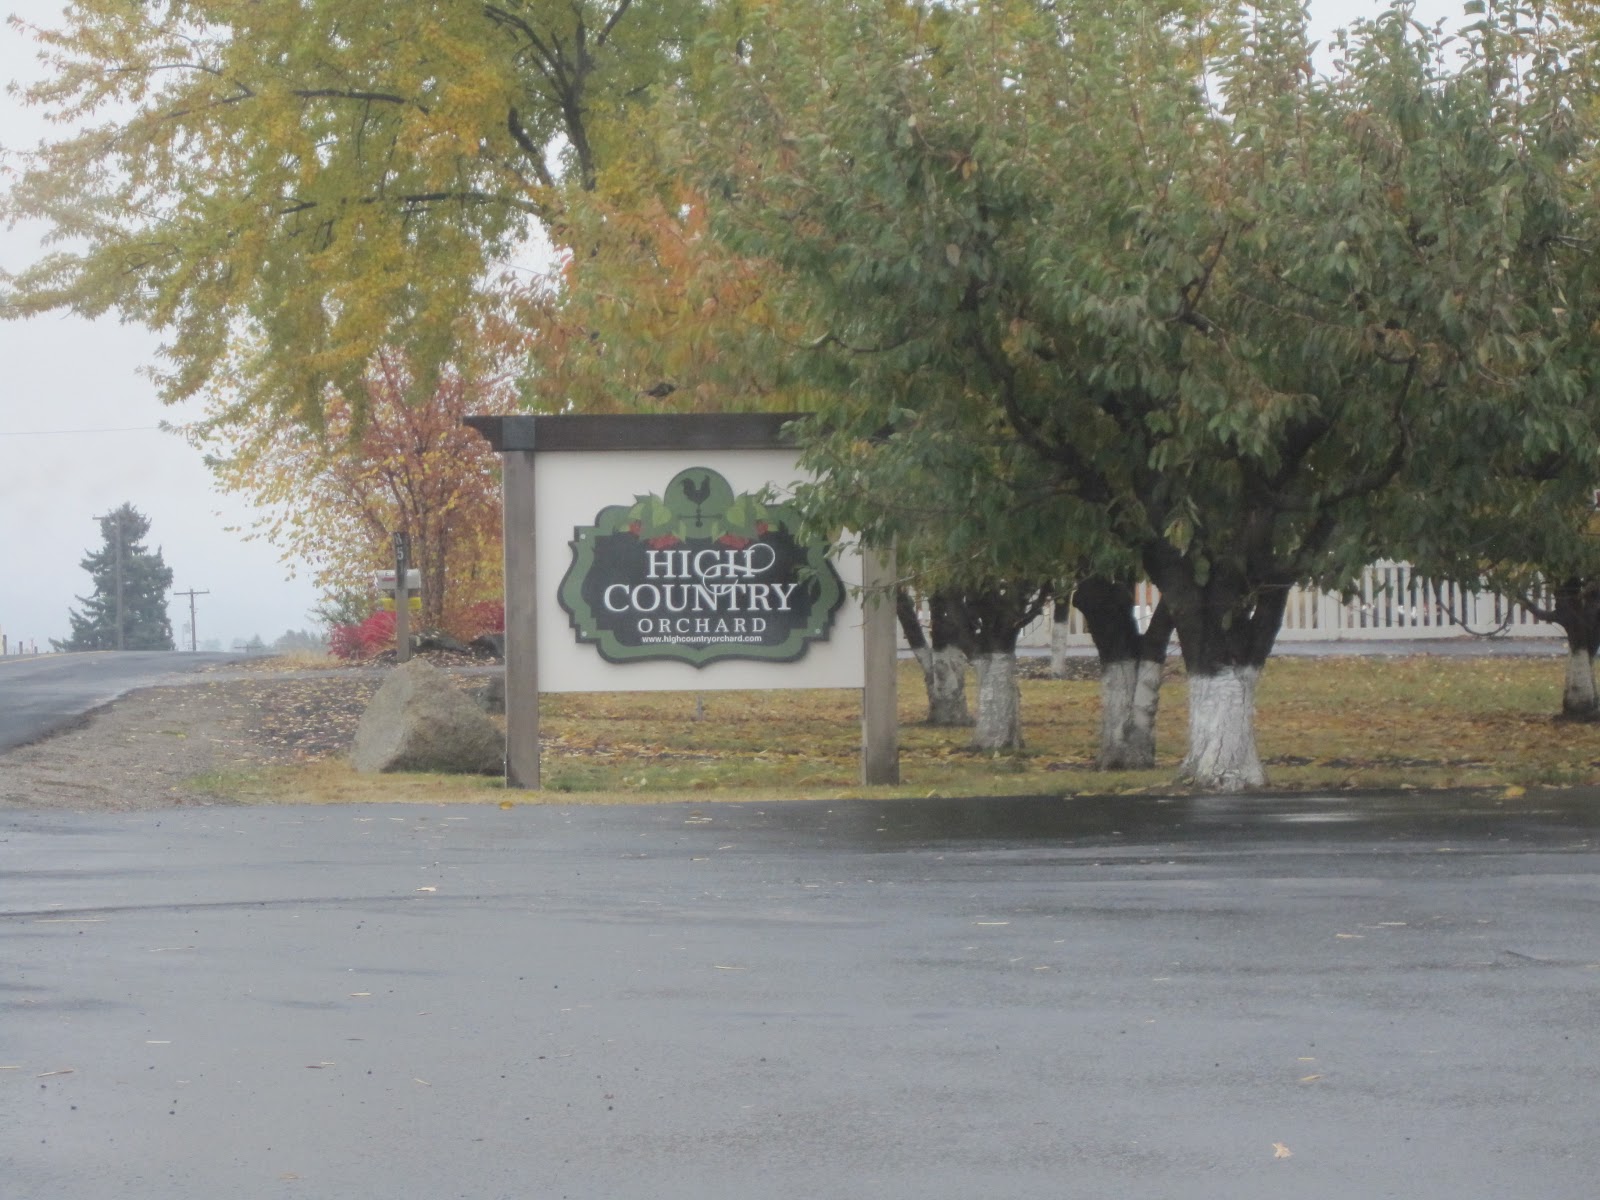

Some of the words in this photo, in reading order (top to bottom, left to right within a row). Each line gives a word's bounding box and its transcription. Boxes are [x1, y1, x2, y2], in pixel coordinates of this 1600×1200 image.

[646, 543, 775, 579] HIGH
[604, 583, 798, 612] COUNTRY
[638, 617, 767, 633] ORCHARD
[641, 634, 763, 644] www.highcountryorchard.com
